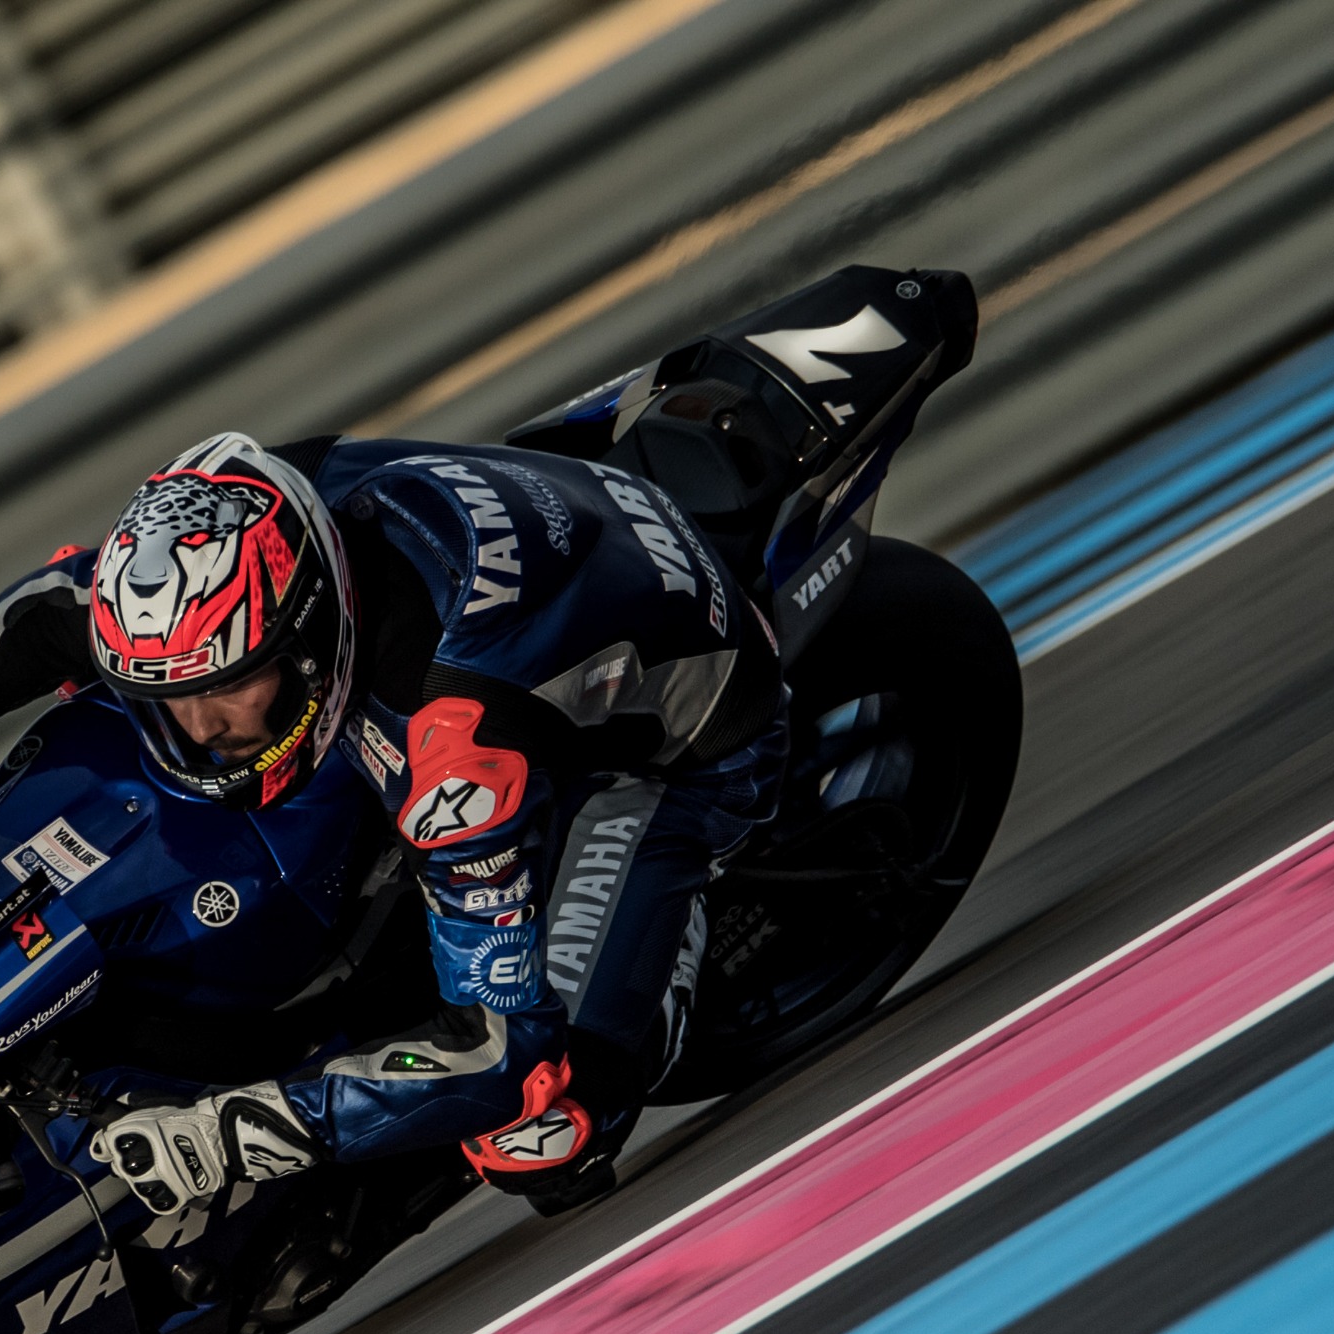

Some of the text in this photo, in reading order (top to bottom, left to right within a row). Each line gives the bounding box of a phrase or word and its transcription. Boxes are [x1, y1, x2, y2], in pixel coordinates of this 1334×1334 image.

[744, 303, 908, 385] 7
[791, 537, 855, 611] YART
[107, 649, 211, 682] LS2
[254, 700, 319, 773] allimand
[53, 826, 102, 868] YAMALUBE
[546, 816, 641, 994] YAMAHA
